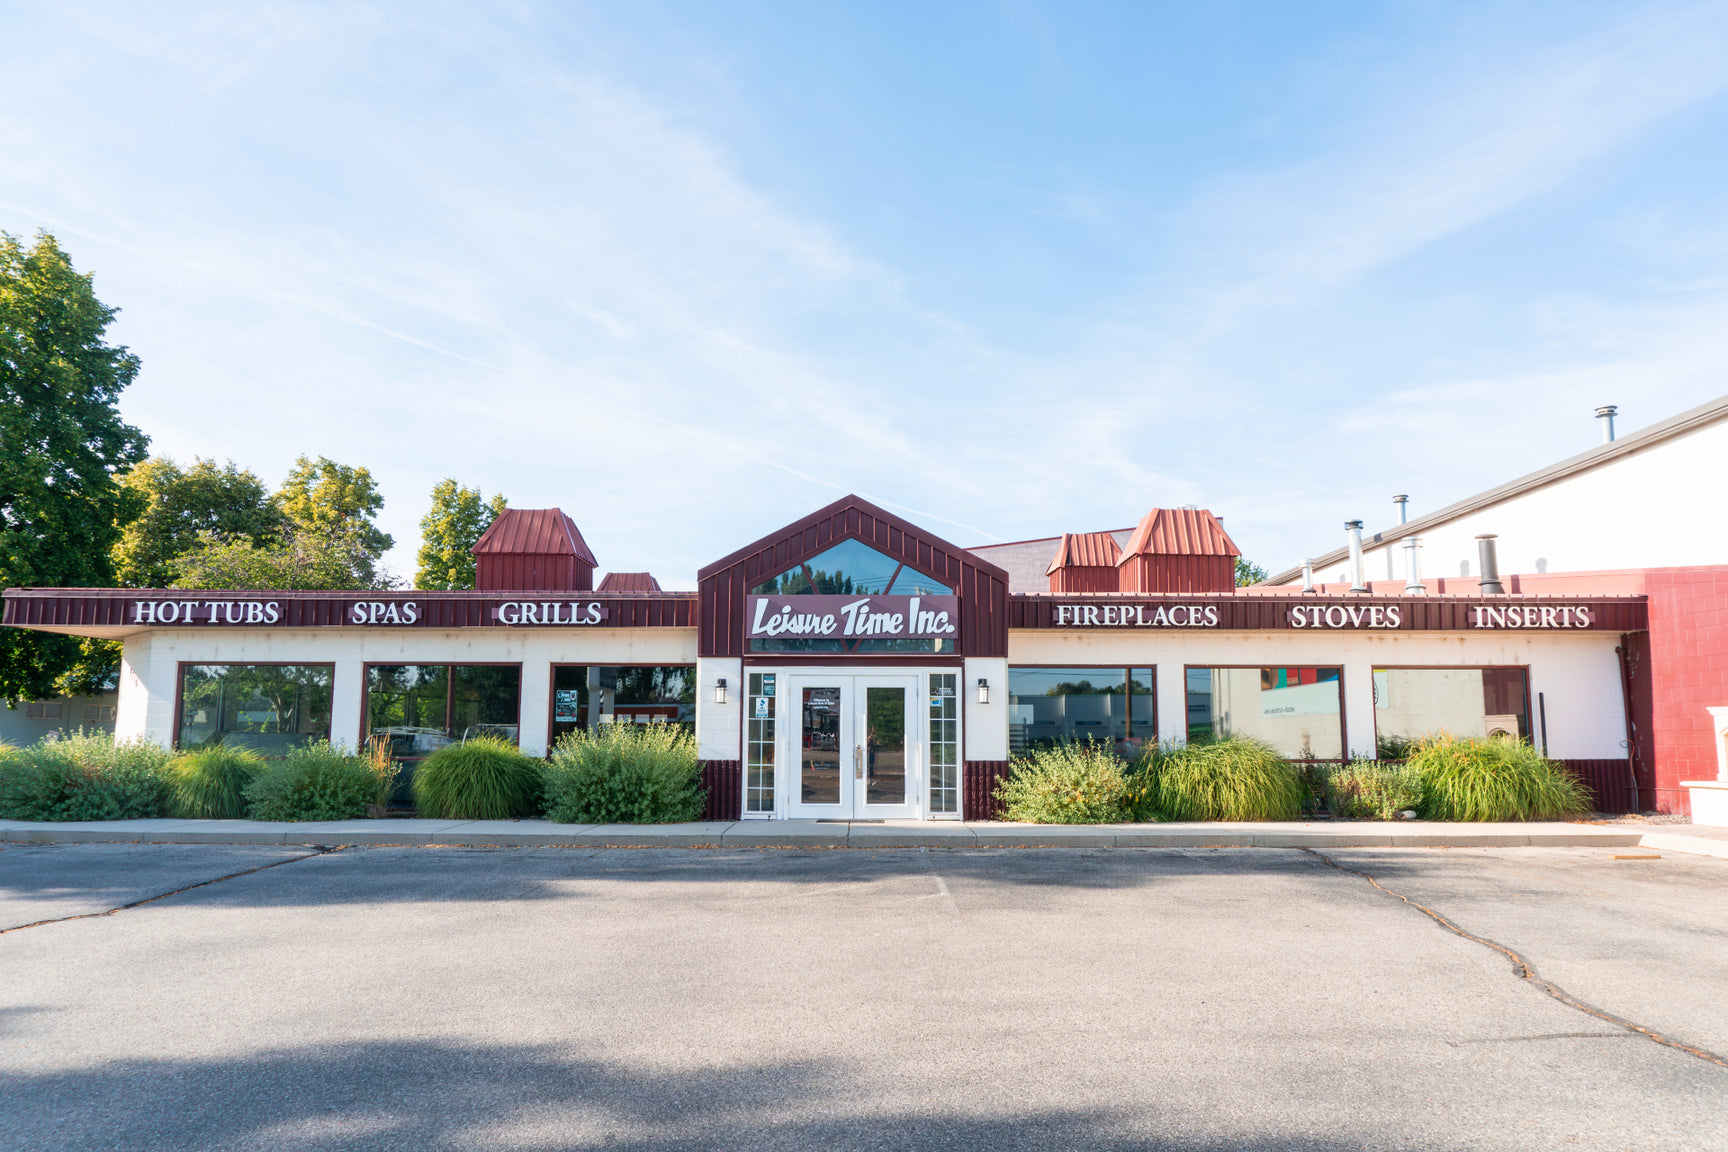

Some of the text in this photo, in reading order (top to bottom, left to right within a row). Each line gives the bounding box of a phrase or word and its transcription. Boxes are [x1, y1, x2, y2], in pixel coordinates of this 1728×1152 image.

[133, 601, 279, 624] HOT TUBS
[352, 601, 417, 624] SPAS
[498, 602, 602, 625] GRILLS
[752, 597, 956, 636] Leisure Time Inc.
[1056, 605, 1218, 626] FIREPLACES
[1291, 605, 1401, 628] STOVES
[1473, 606, 1590, 628] INSERTS
